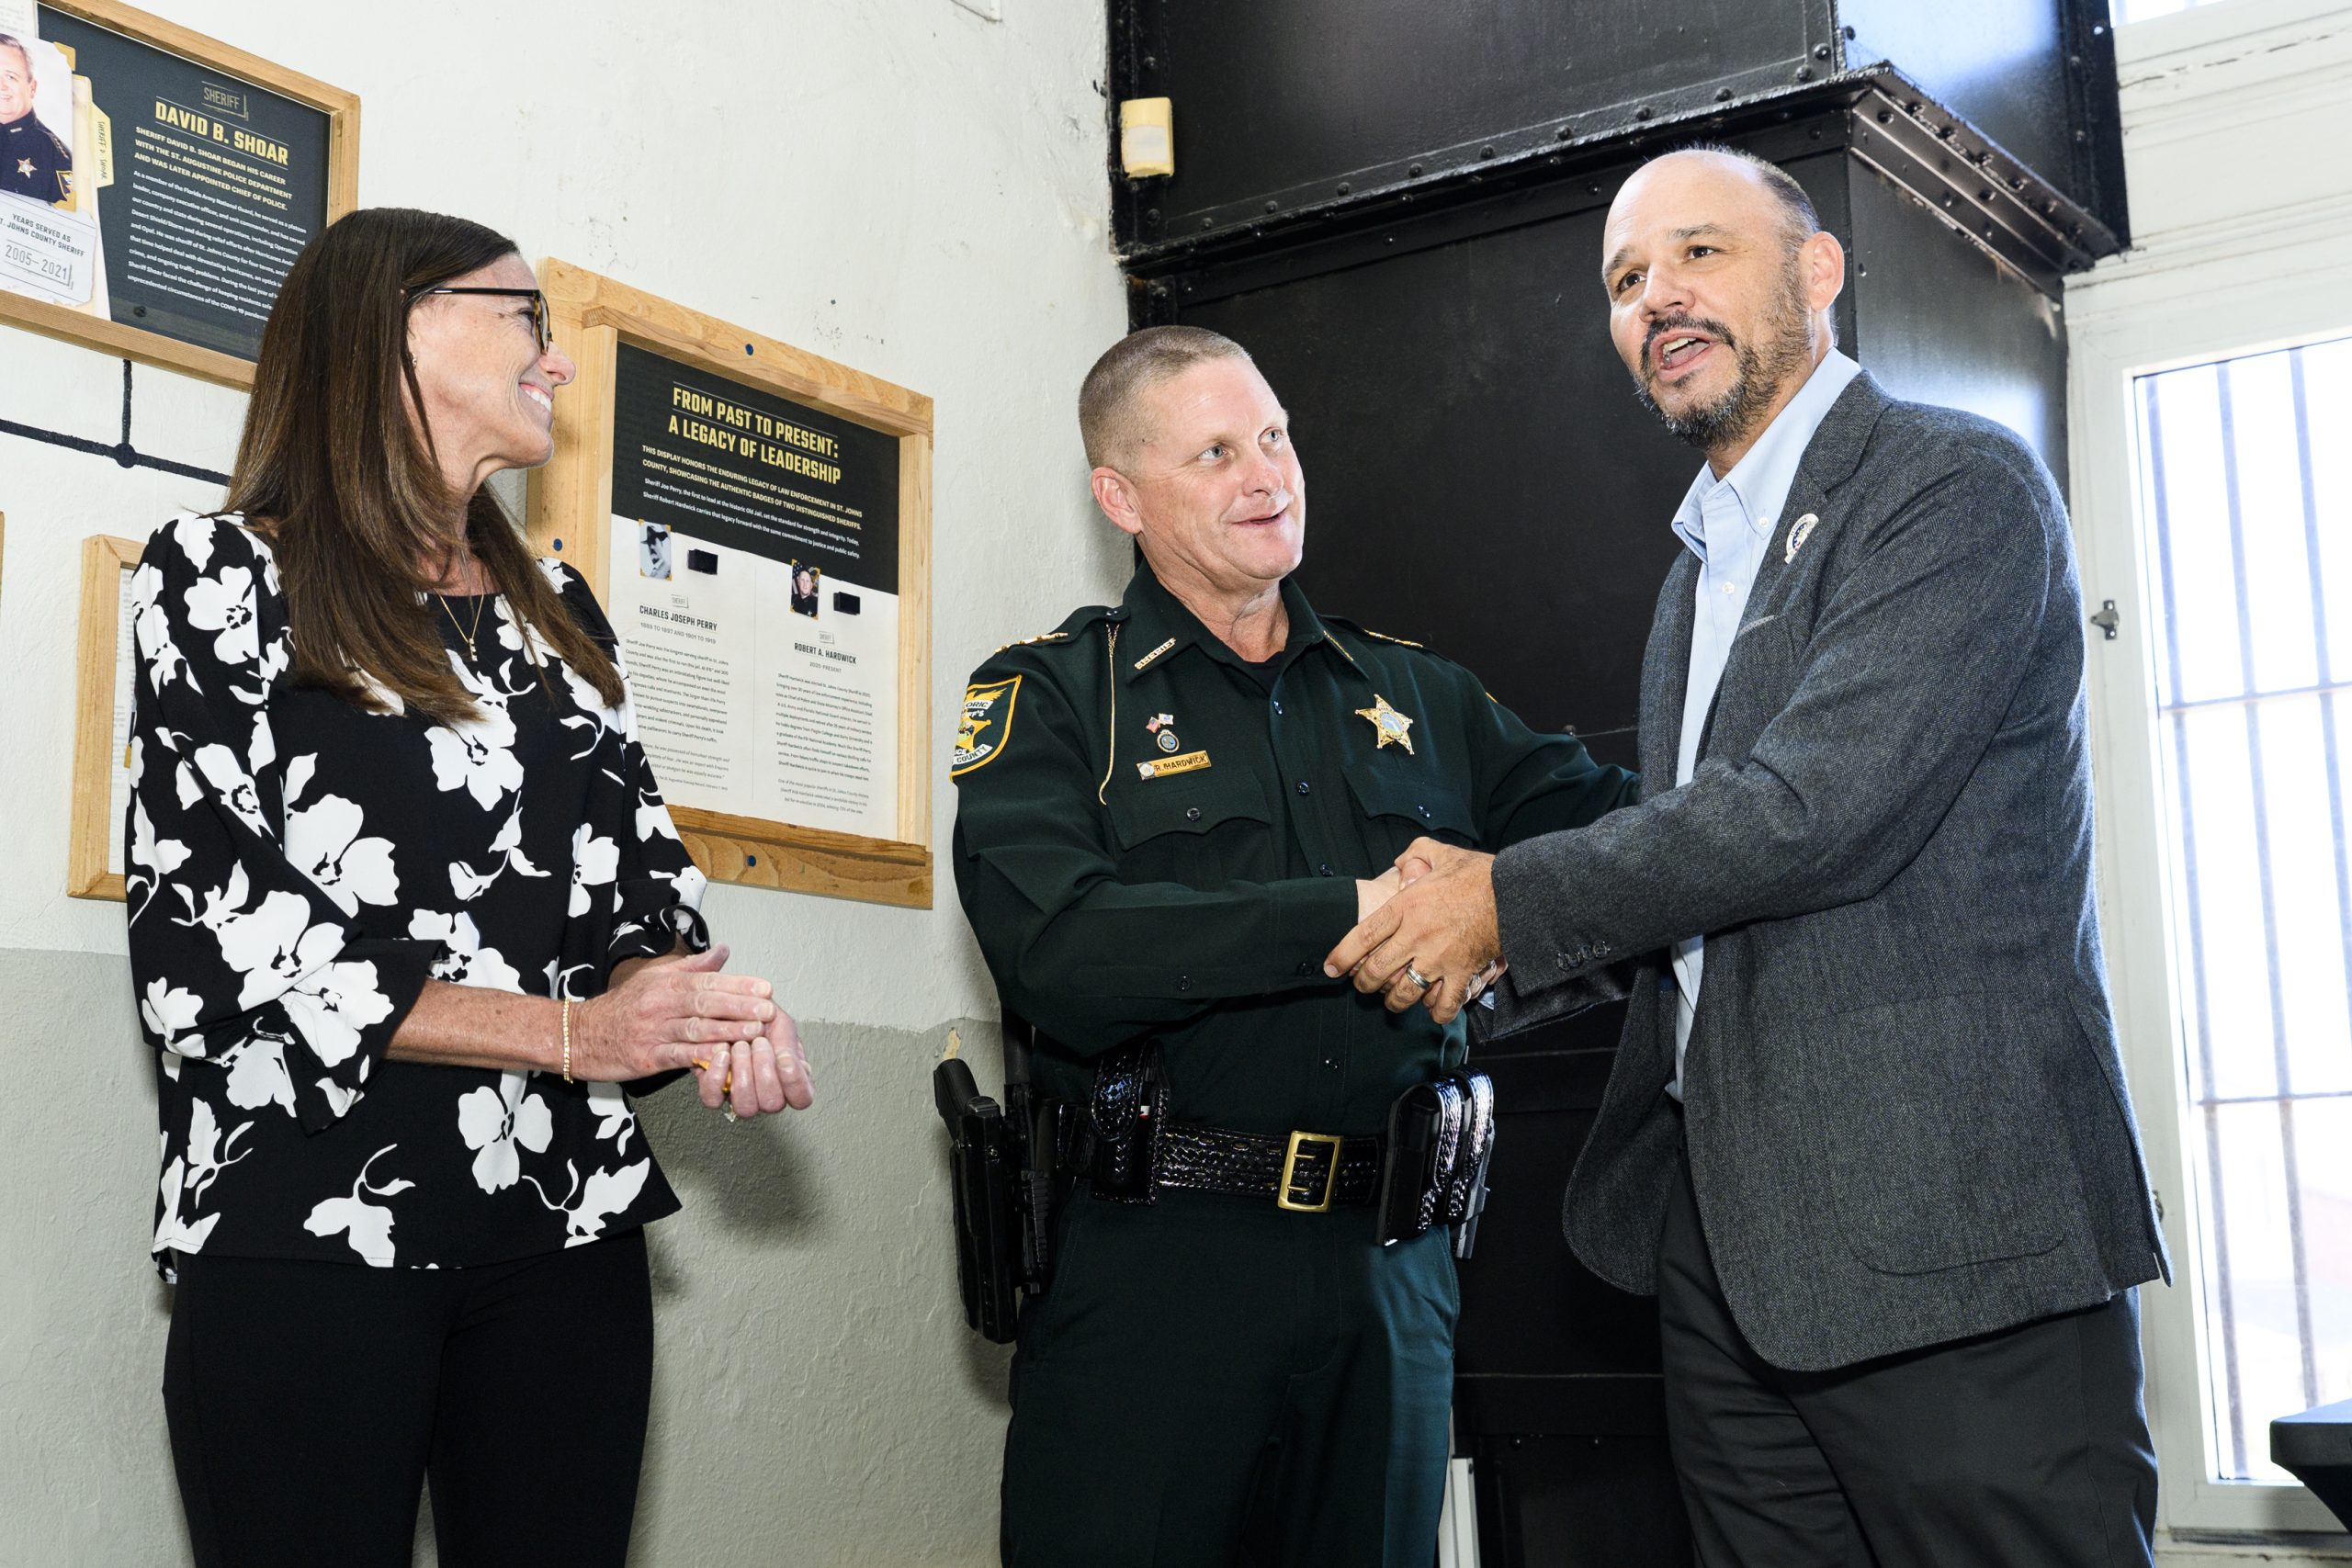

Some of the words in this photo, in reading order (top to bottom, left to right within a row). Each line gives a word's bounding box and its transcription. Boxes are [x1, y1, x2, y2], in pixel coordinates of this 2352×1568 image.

[203, 87, 240, 109] SHERIFF
[136, 126, 166, 141] SHERIFF
[166, 137, 188, 150] DAVID
[189, 145, 197, 153] B.
[198, 149, 221, 163] SHOAR
[222, 157, 246, 171] BEGAN
[247, 166, 259, 175] HIS
[259, 171, 286, 185] CAREER
[155, 101, 208, 136] DAVID
[212, 122, 229, 144] B.
[234, 130, 288, 165] SHOAR
[134, 152, 151, 163] AND
[152, 157, 168, 169] WAS
[169, 164, 191, 176] LATER
[191, 172, 231, 190] APPOINTED
[231, 186, 252, 197] CHIEF
[252, 193, 262, 201] OF
[262, 197, 288, 210] POLICE.
[135, 139, 154, 152] WITH
[155, 146, 170, 157] THE
[171, 152, 182, 161] ST.
[182, 156, 222, 175] AUGUSTINE
[222, 170, 247, 184] POLICE
[248, 179, 292, 199] DEPARTMENT
[6, 221, 29, 235] JOHNS
[30, 231, 57, 245] COUNTY
[58, 242, 85, 256] SHERIFF
[13, 214, 34, 228] YEARS
[35, 223, 61, 239] SERVED
[62, 234, 71, 243] AS
[668, 415, 679, 434] A
[683, 419, 736, 452] LEGACY
[740, 437, 757, 458] OF
[761, 444, 841, 484] LEADERSHIP
[673, 387, 712, 417] FROM
[717, 401, 752, 429] PAST
[755, 414, 772, 436] TO
[775, 422, 838, 458] PRESENT:
[642, 445, 656, 455] THIS
[657, 449, 681, 462] DISPLAY
[681, 457, 706, 470] HONORS
[707, 464, 718, 474] THE
[718, 468, 748, 483] ENDURING
[748, 478, 770, 489] LEGACY
[777, 486, 790, 496] LAW
[790, 490, 830, 507] ENFORCEMENT
[836, 504, 844, 513] ST.
[844, 507, 863, 518] JOHNS
[642, 458, 668, 474] COUNTY,
[669, 467, 708, 484] SHOWCASING
[708, 479, 720, 488] THE
[720, 482, 752, 498] AUTHENTIC
[752, 491, 775, 504] BADGES
[783, 501, 796, 511] TWO
[796, 504, 836, 523] DISTINGUISHED
[836, 517, 862, 530] SHERIFFS.
[639, 605, 669, 620] CHARLES
[670, 613, 695, 626] JOSEPH
[696, 619, 718, 631] PERRY
[794, 642, 817, 654] ROBERT
[818, 649, 824, 657] A.
[825, 649, 856, 664] HARDWICK
[956, 746, 988, 762] COUNTY
[1164, 755, 1207, 770] HARDWICK
